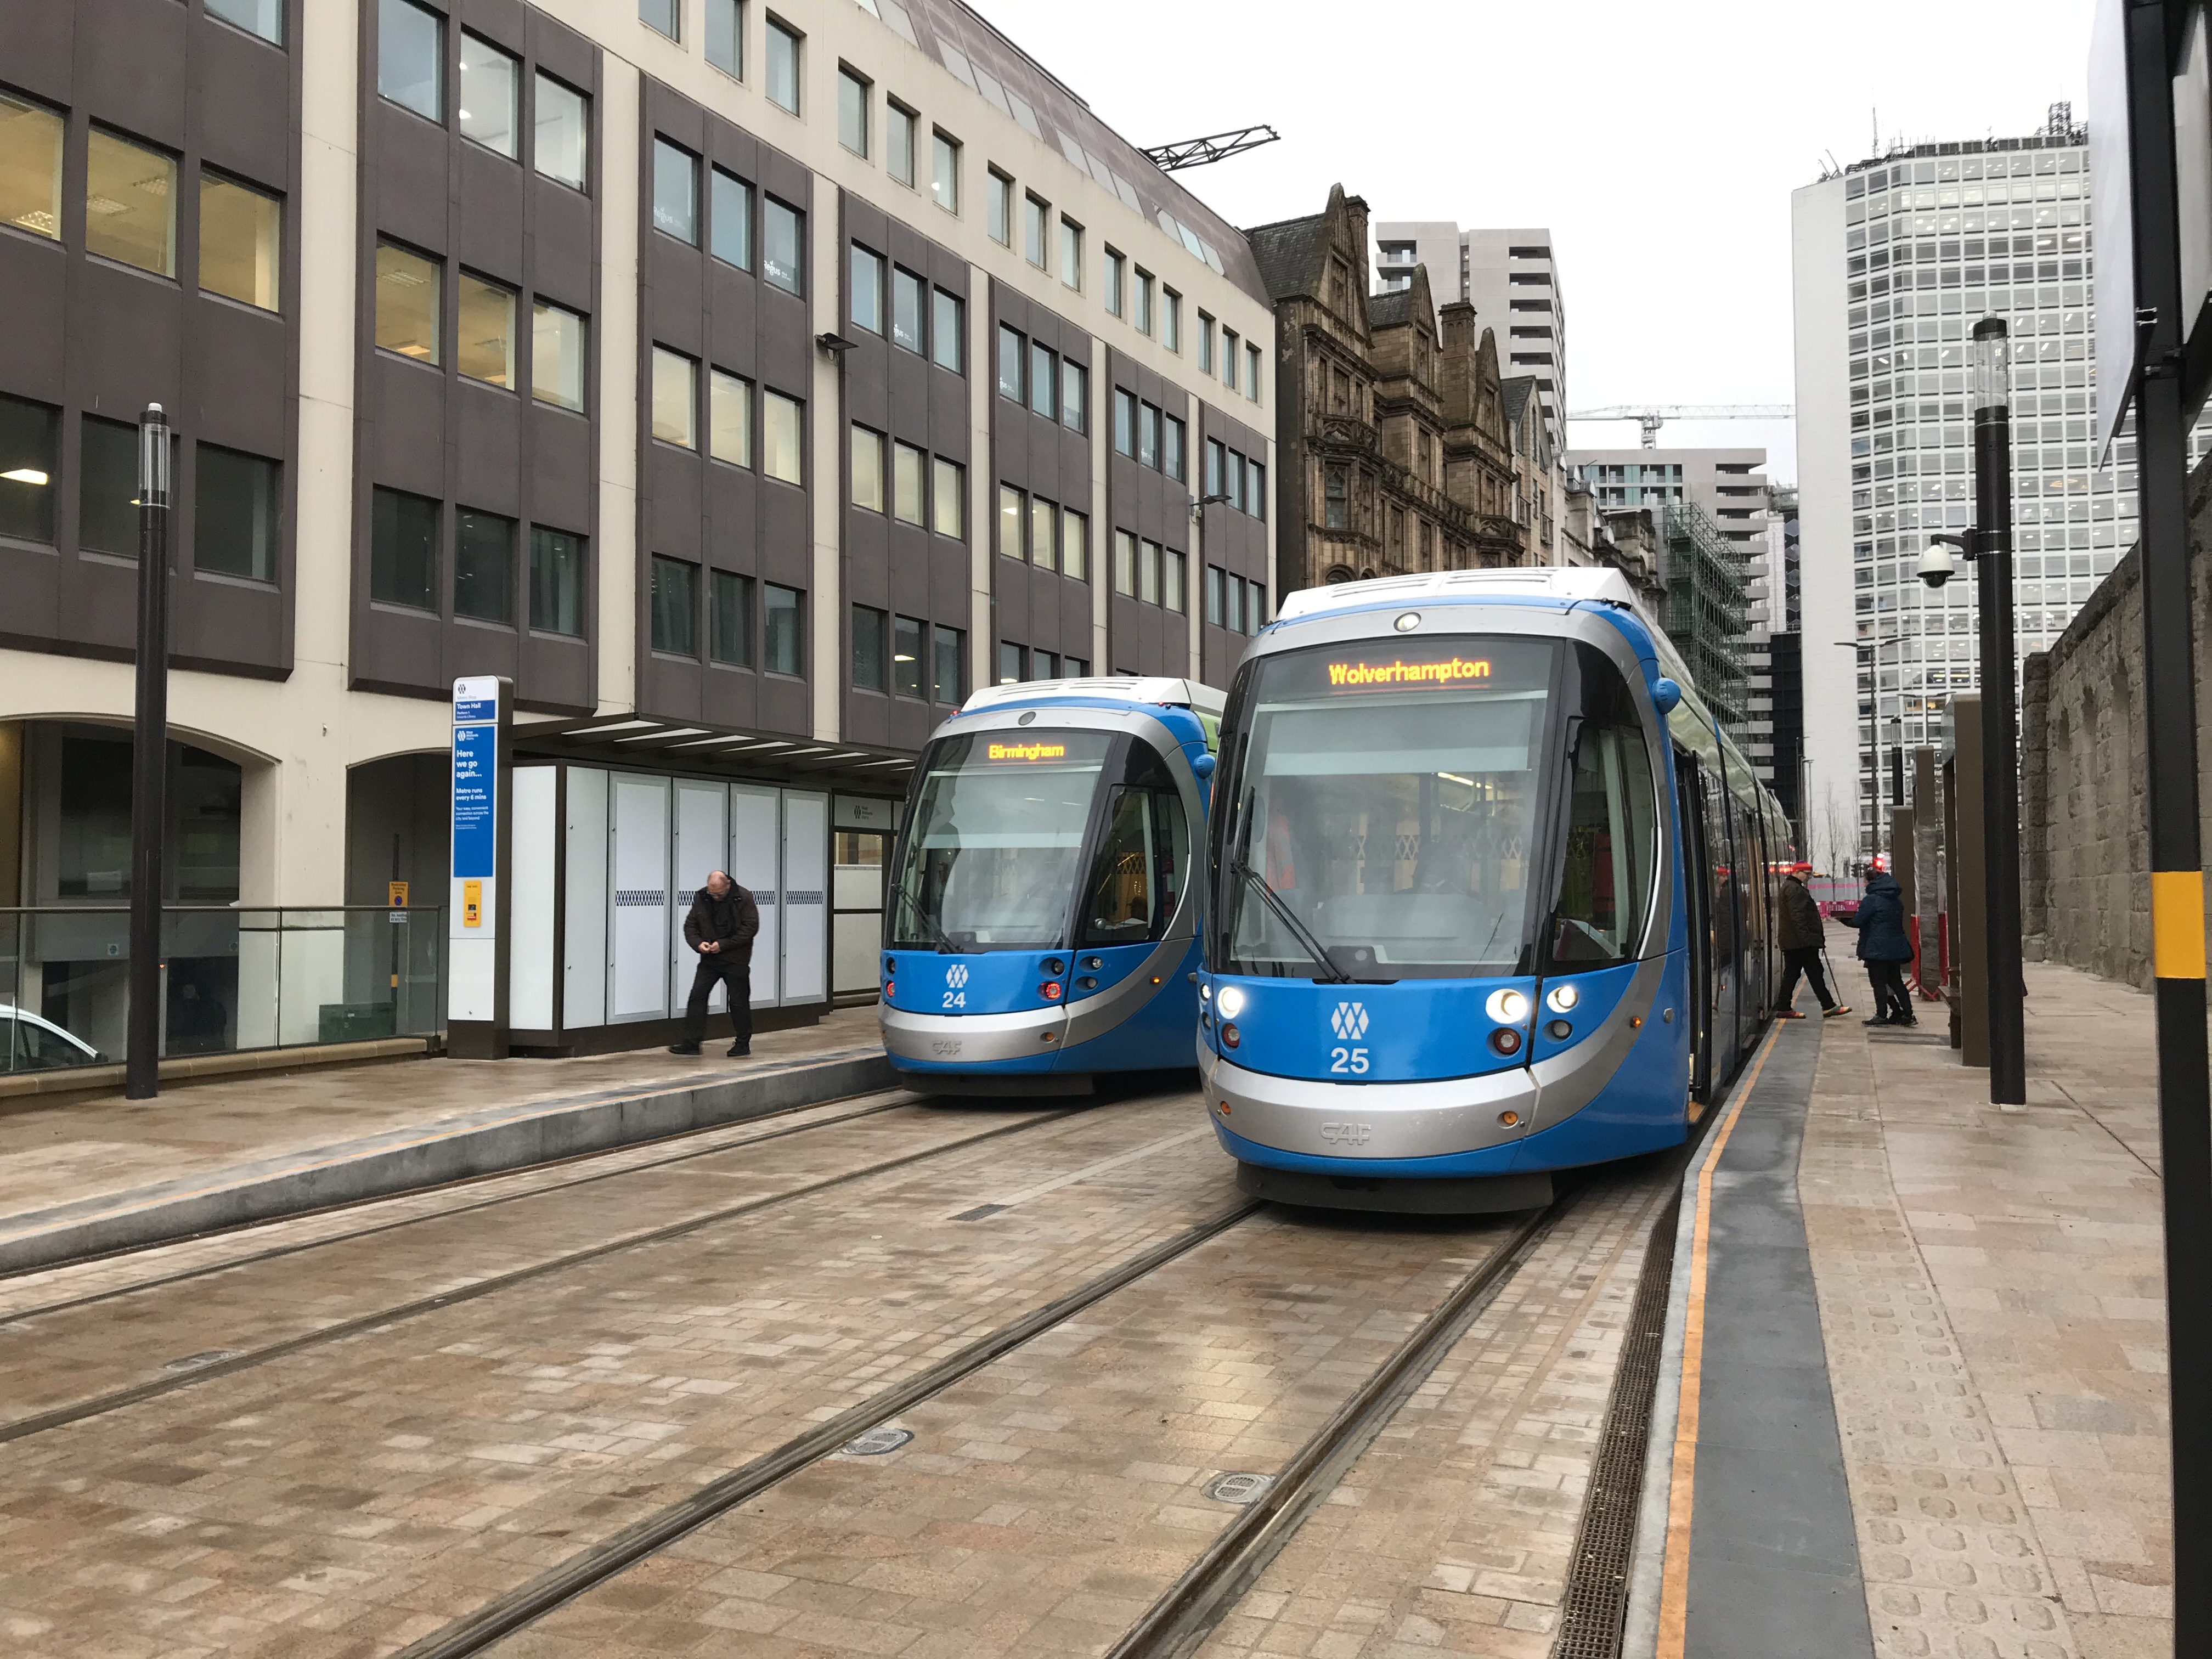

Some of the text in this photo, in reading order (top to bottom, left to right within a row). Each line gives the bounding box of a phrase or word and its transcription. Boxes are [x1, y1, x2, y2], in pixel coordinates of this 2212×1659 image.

[1329, 658, 1489, 685] Wolverhampton
[456, 749, 474, 758] Here
[989, 743, 1065, 760] Birmingham
[468, 760, 478, 769] go
[456, 769, 482, 780] again...
[942, 991, 967, 1008] 24
[933, 1040, 962, 1055] CAF
[1330, 1047, 1369, 1074] 25
[1320, 1122, 1371, 1146] CAF
